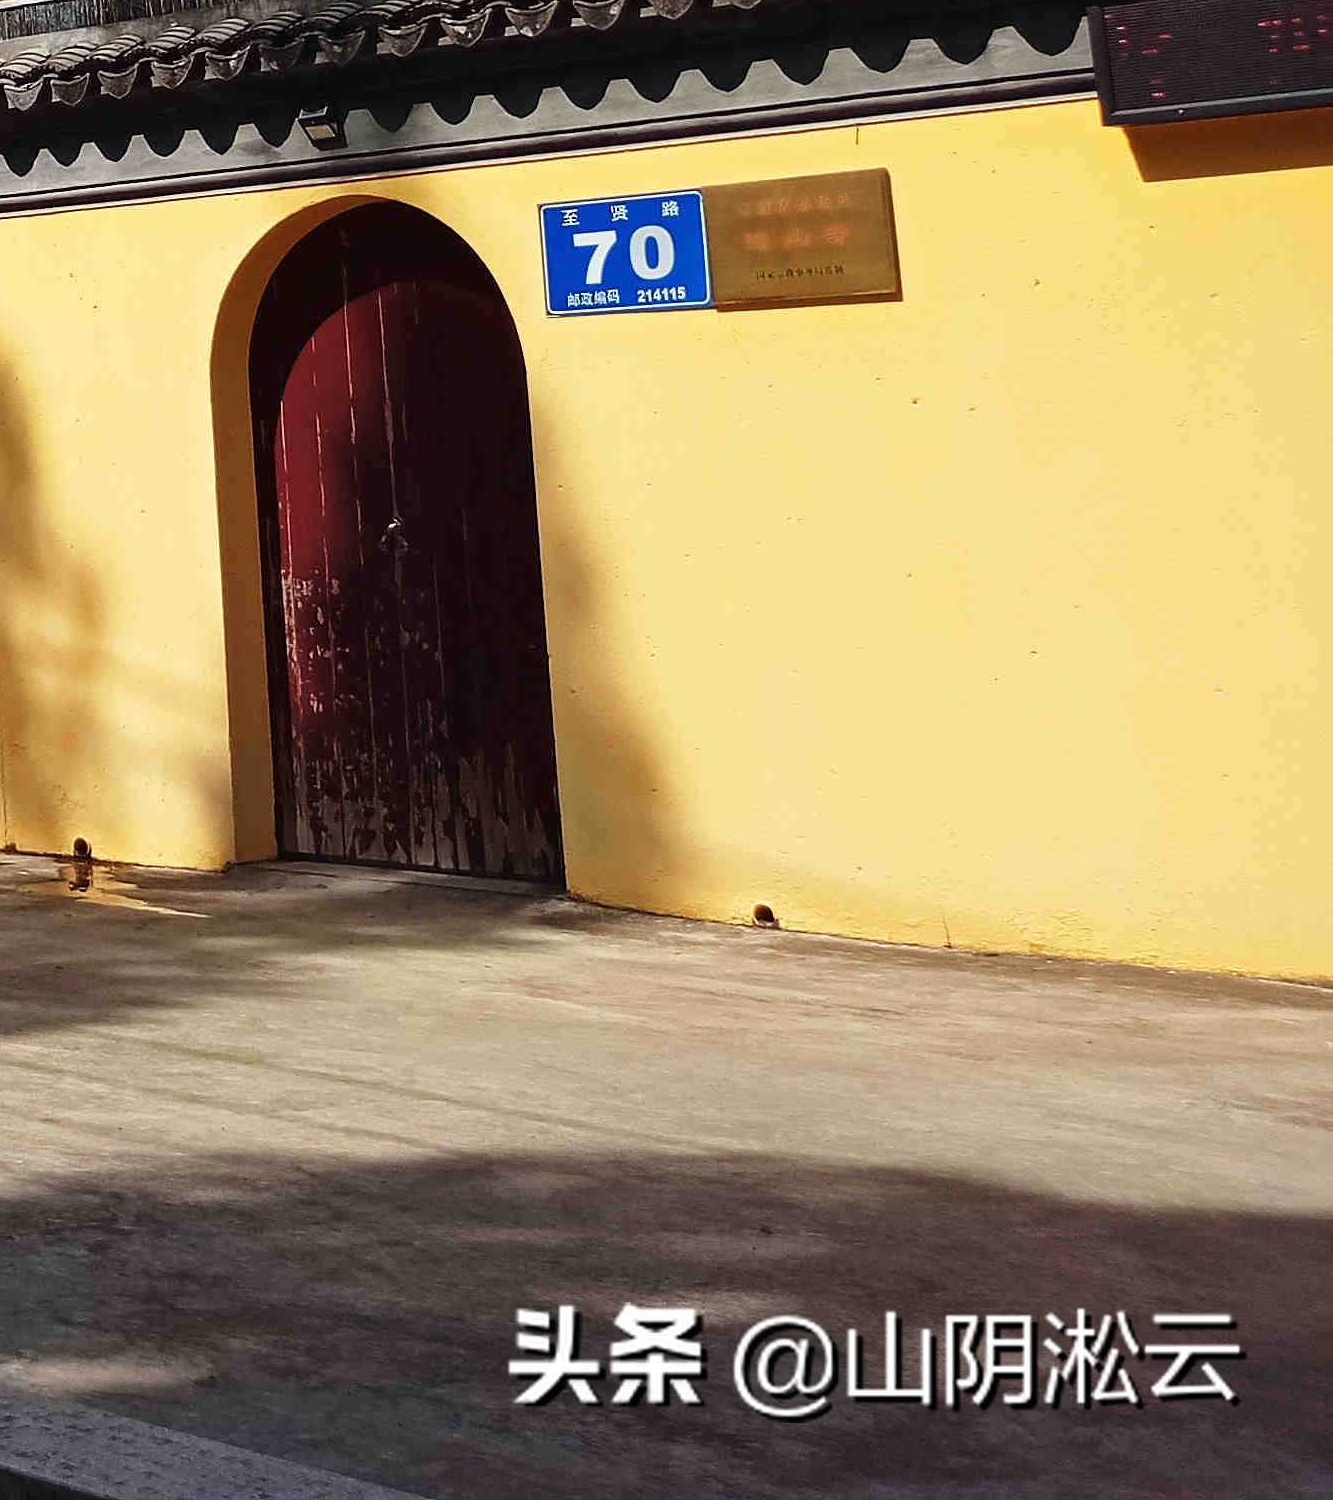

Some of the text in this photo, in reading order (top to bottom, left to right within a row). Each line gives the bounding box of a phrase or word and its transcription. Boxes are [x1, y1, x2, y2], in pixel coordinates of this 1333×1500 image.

[561, 200, 680, 228] 至贤路
[572, 224, 676, 286] 70
[566, 285, 687, 308] 邮政编码 214115
